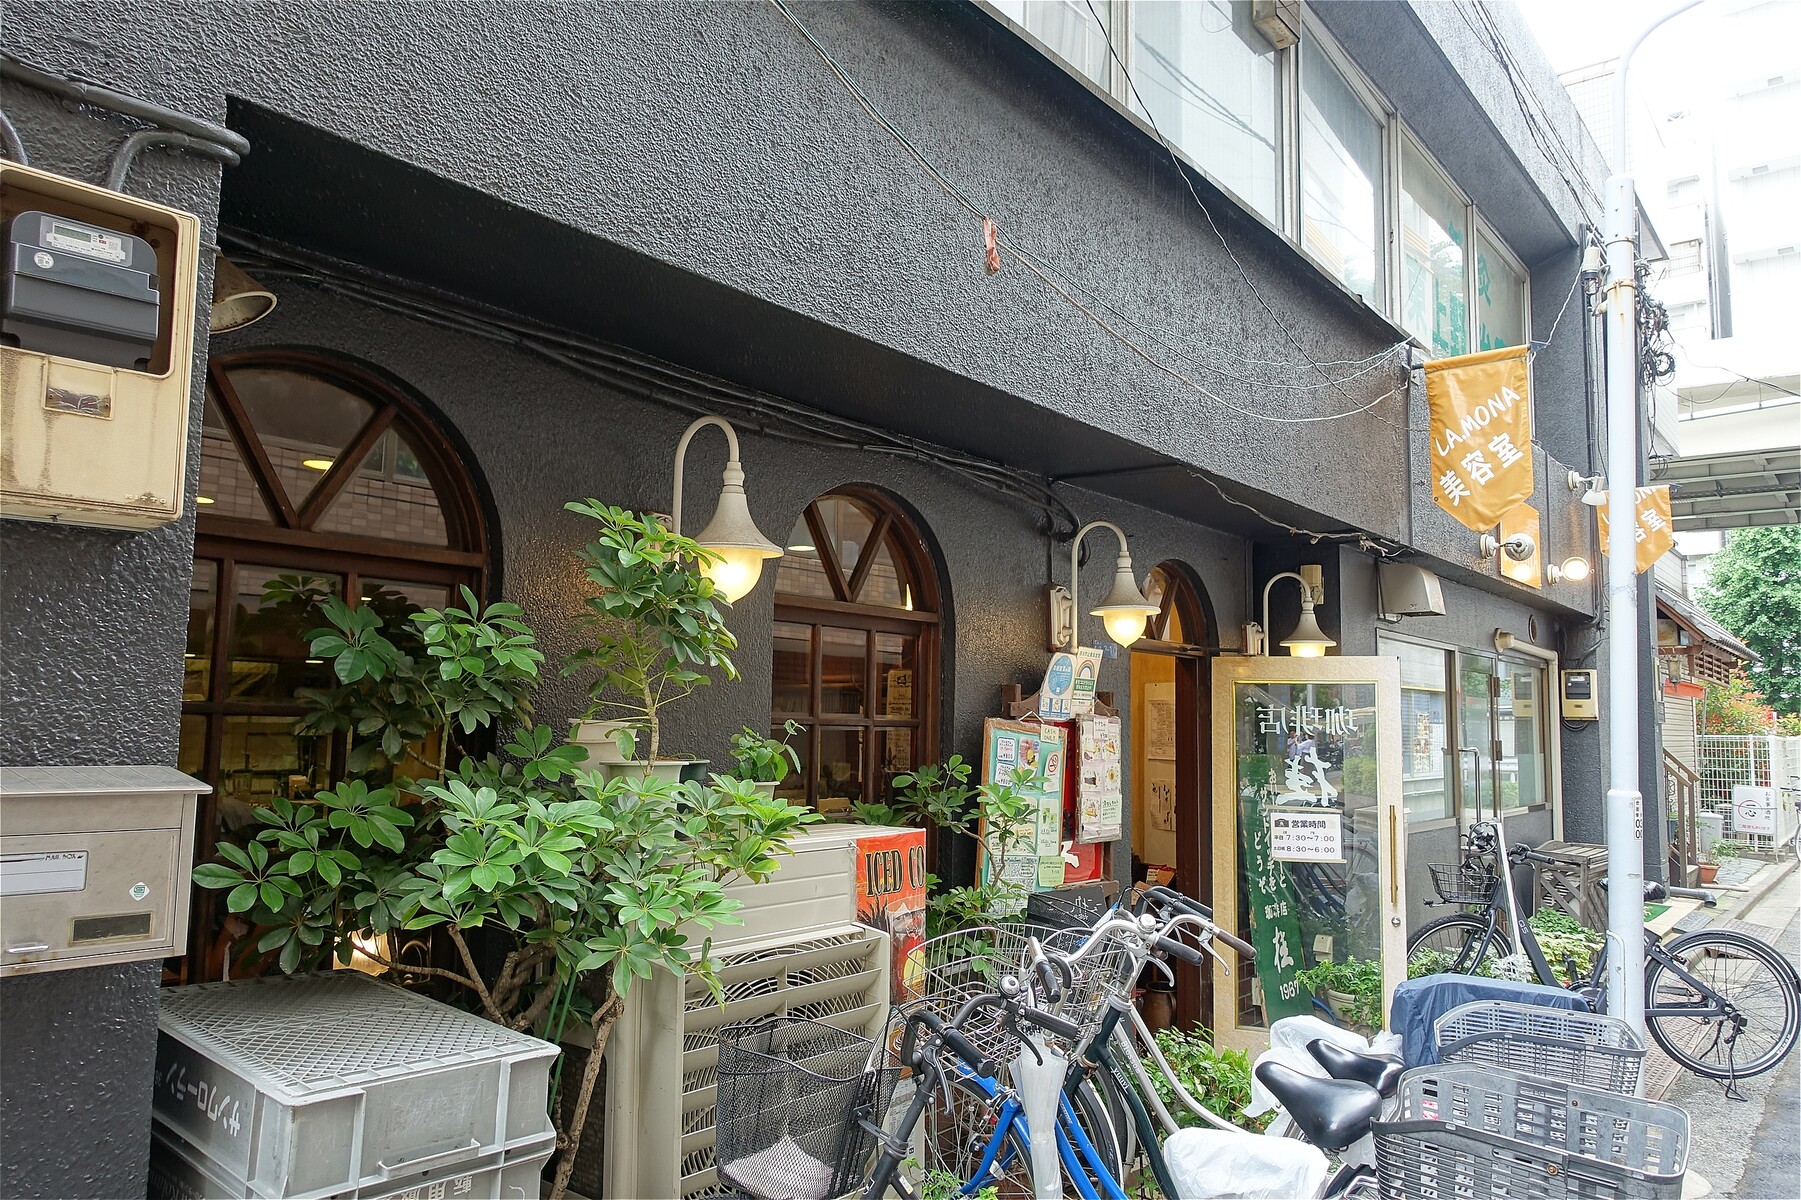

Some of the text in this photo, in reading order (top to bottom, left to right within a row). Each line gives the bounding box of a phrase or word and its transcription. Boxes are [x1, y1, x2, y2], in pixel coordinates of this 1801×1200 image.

[1439, 432, 1524, 507] 美容室
[1291, 820, 1327, 829] 営業時間
[865, 848, 904, 897] ICED
[1254, 831, 1267, 895] どうぞ
